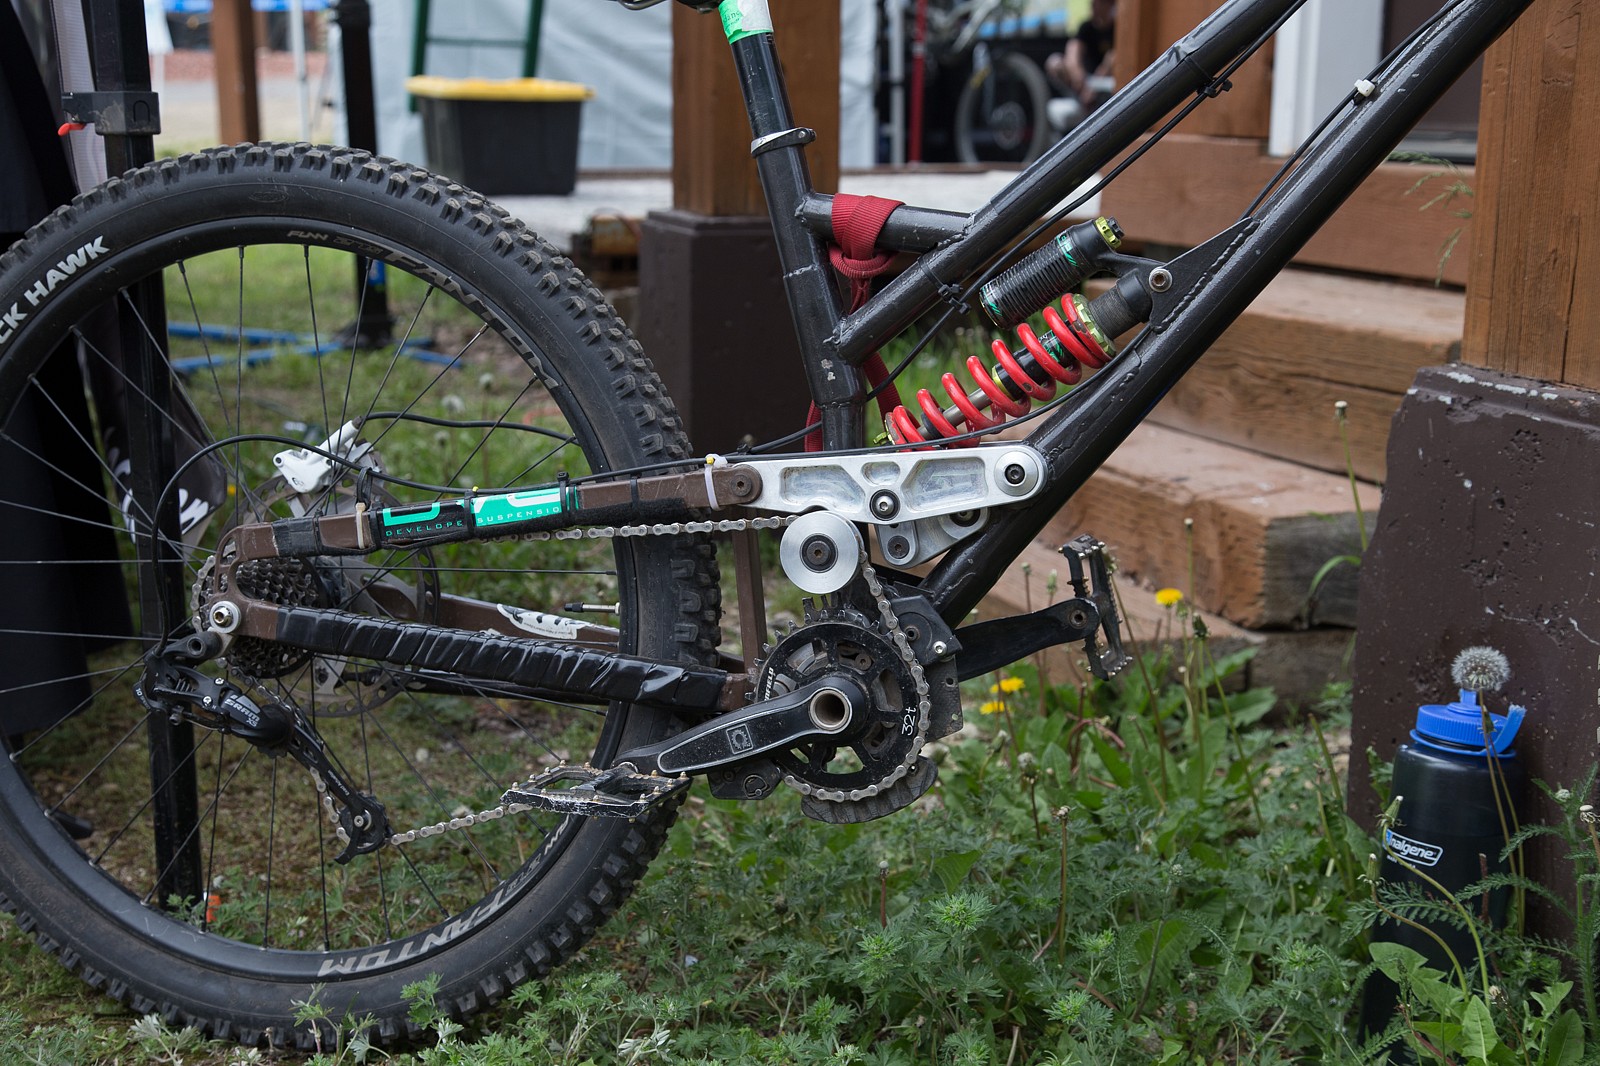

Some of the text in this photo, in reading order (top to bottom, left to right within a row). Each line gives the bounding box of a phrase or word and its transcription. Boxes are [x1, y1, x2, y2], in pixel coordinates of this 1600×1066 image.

[24, 235, 110, 306] HAWK
[385, 506, 560, 537] DEVELOPE SUSPENSIO
[225, 698, 260, 722] SRAM
[901, 706, 917, 736] 32t
[1391, 838, 1436, 861] nalgene
